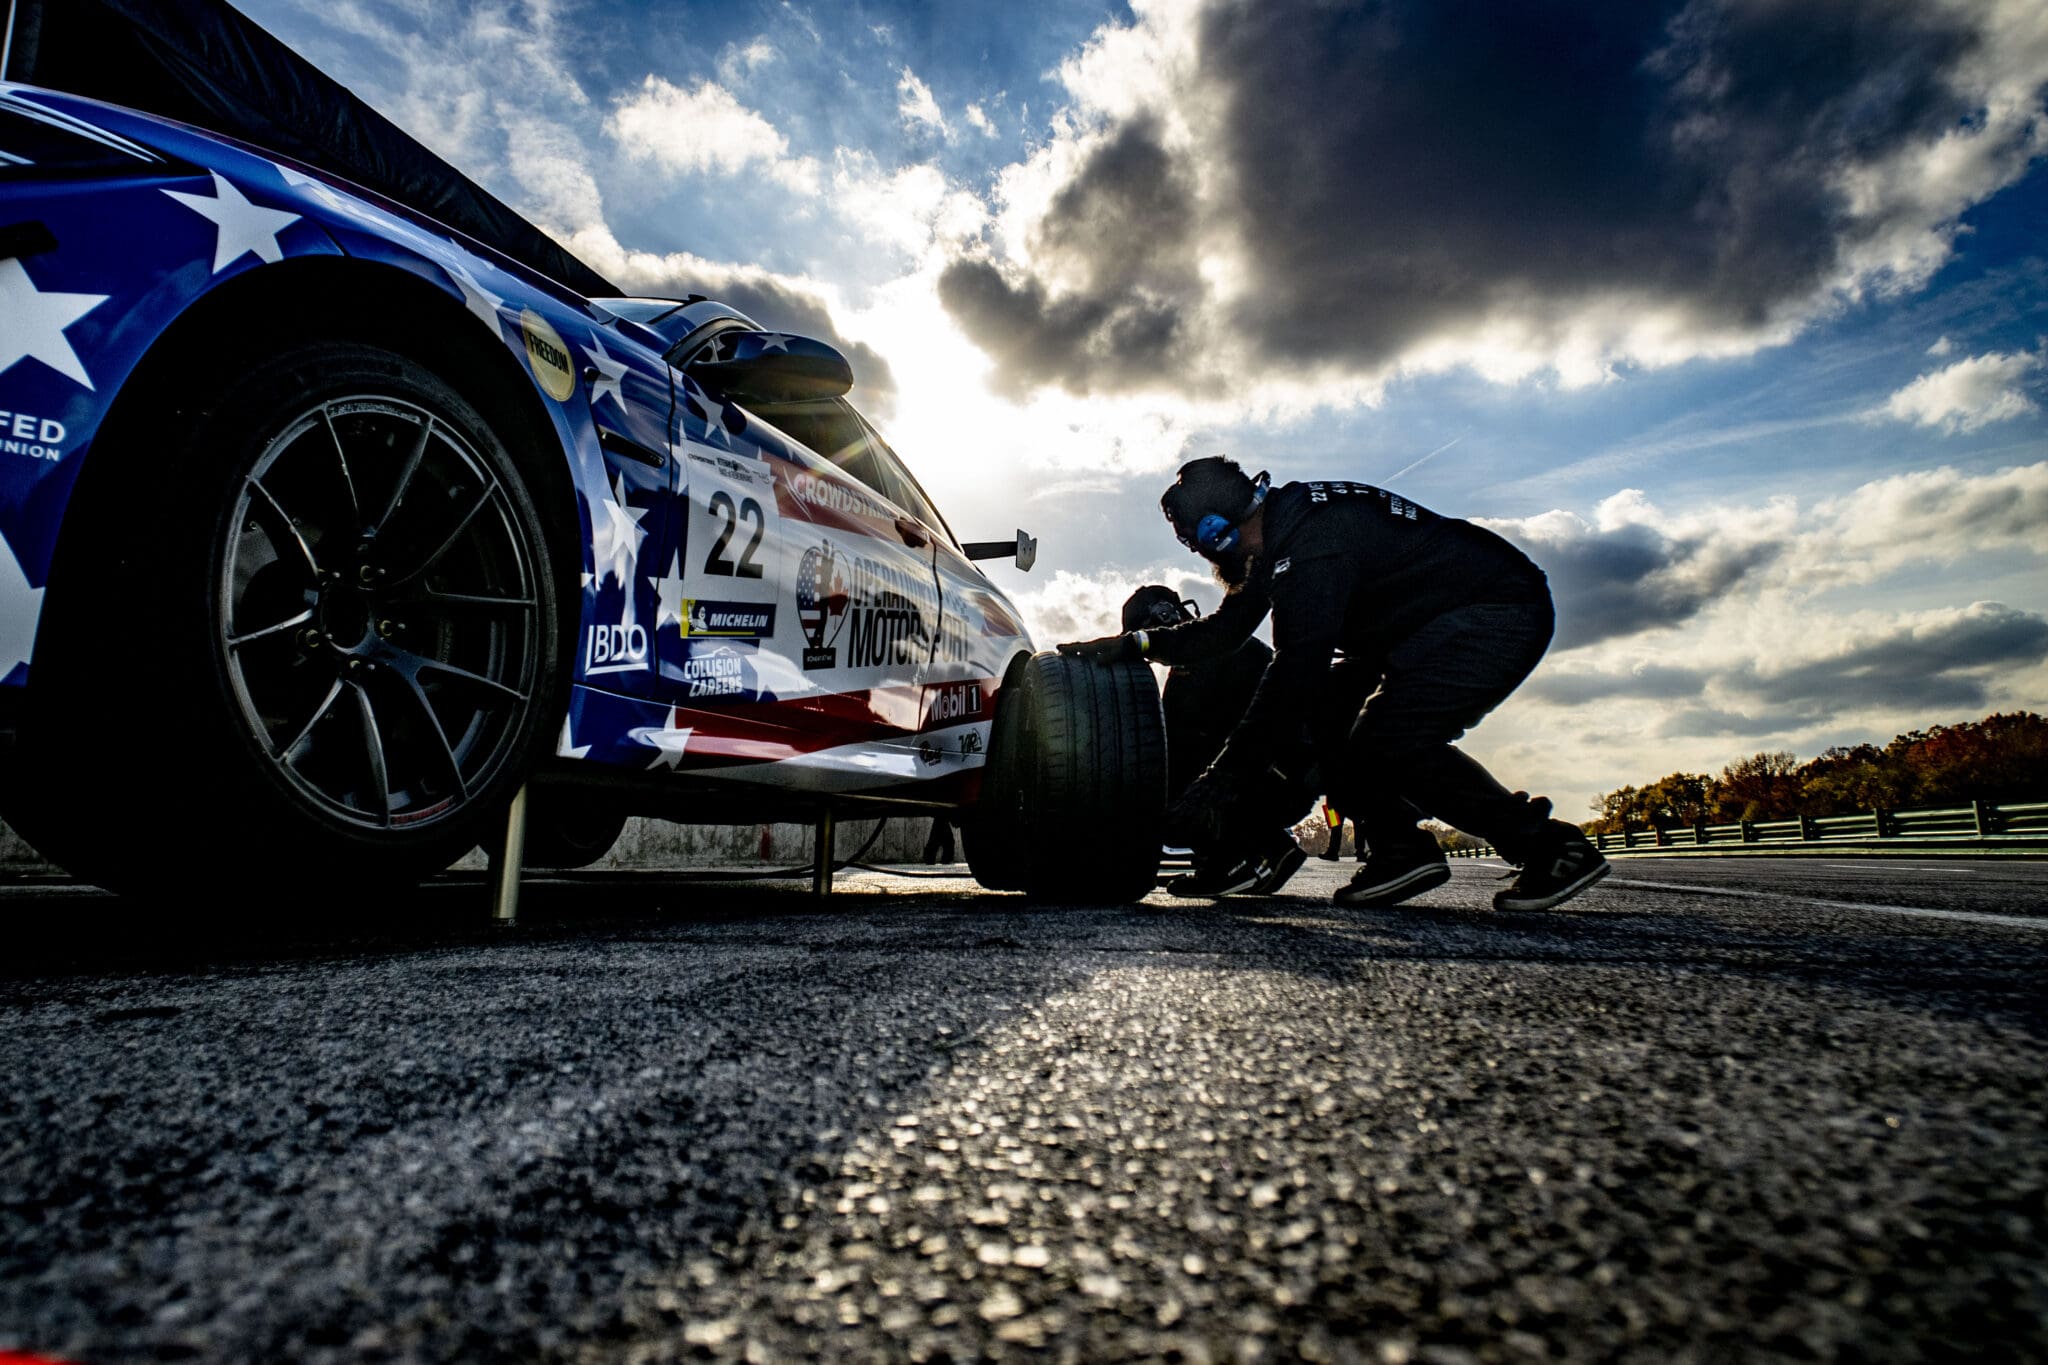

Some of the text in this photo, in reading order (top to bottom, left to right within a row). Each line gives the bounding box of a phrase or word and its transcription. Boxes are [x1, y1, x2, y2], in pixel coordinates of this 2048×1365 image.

[528, 331, 570, 375] FREEDOM
[0, 439, 60, 461] NION
[704, 490, 764, 579] 22
[709, 613, 769, 627] MICHELIN
[684, 658, 742, 679] COLLISION
[689, 675, 743, 697] CAREERS
[930, 685, 966, 722] Mobil
